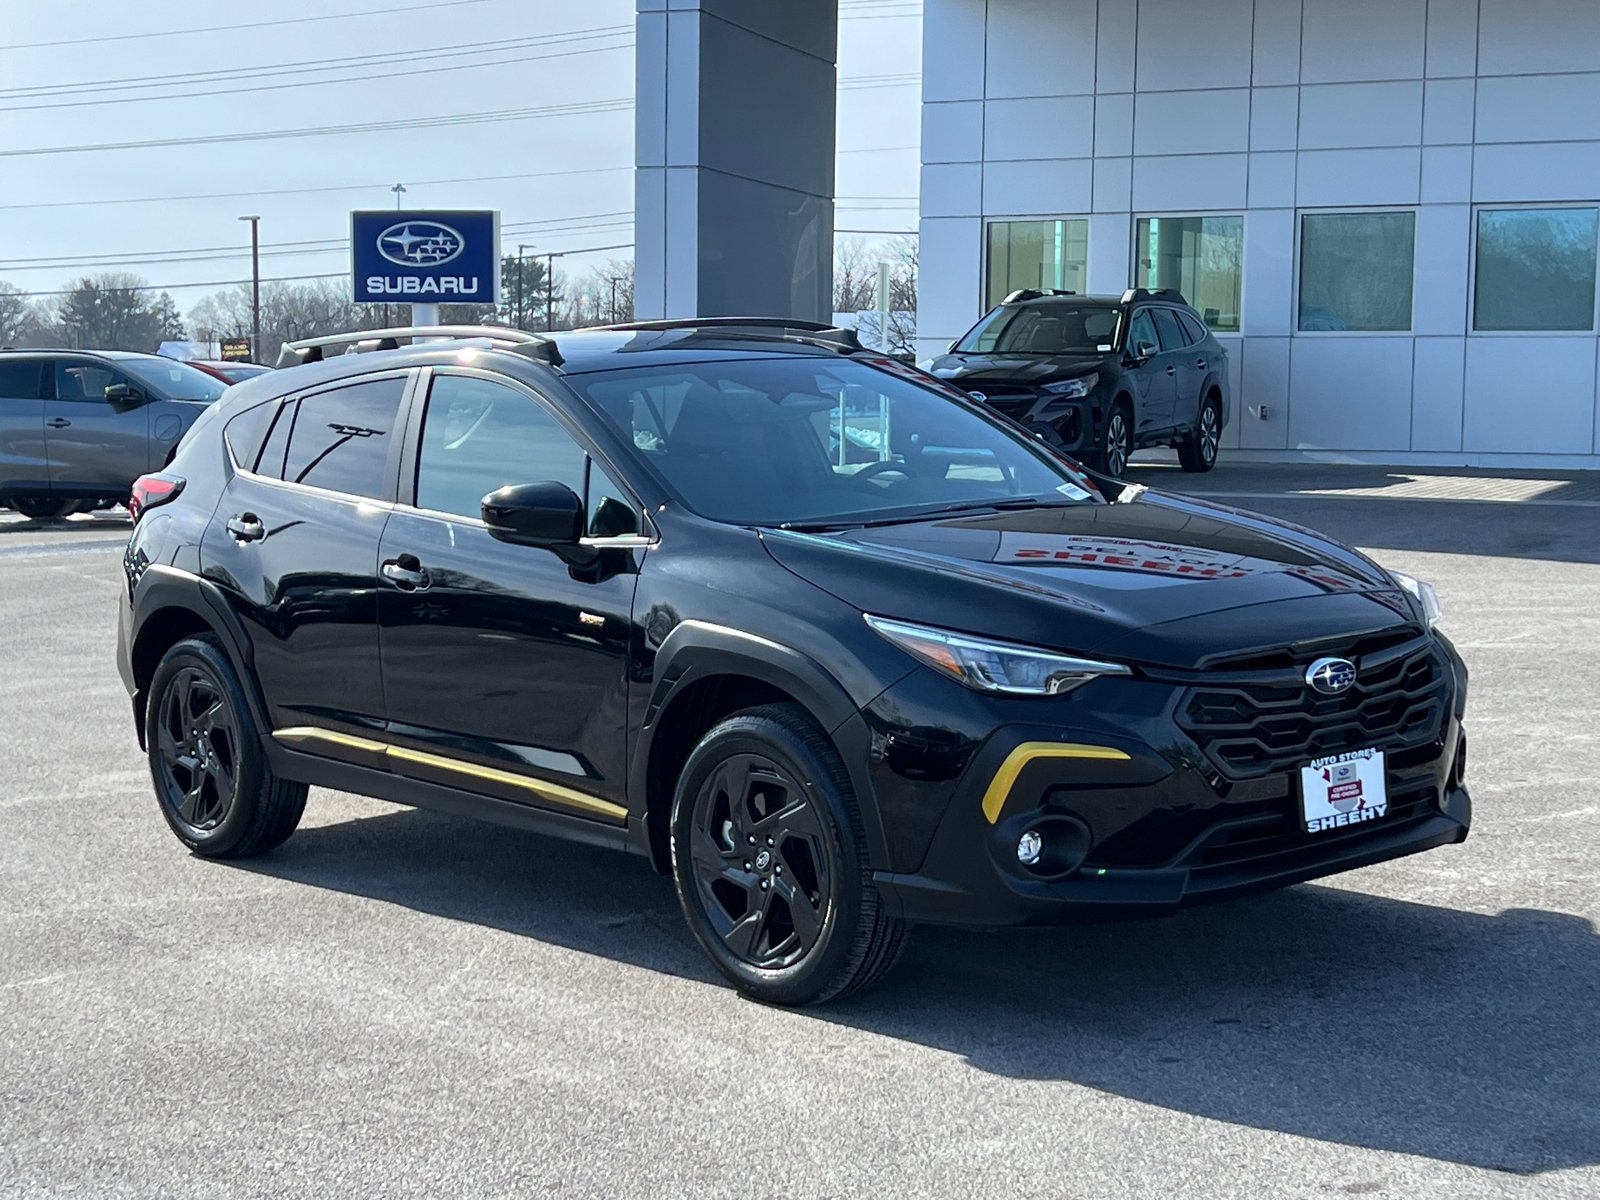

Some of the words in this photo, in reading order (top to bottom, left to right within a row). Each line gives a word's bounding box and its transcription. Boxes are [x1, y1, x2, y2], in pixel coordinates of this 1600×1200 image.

[366, 276, 478, 294] SUBARU
[1310, 755, 1337, 768] AUTO
[1338, 747, 1377, 763] STORES
[1307, 804, 1388, 833] SHEEHY
